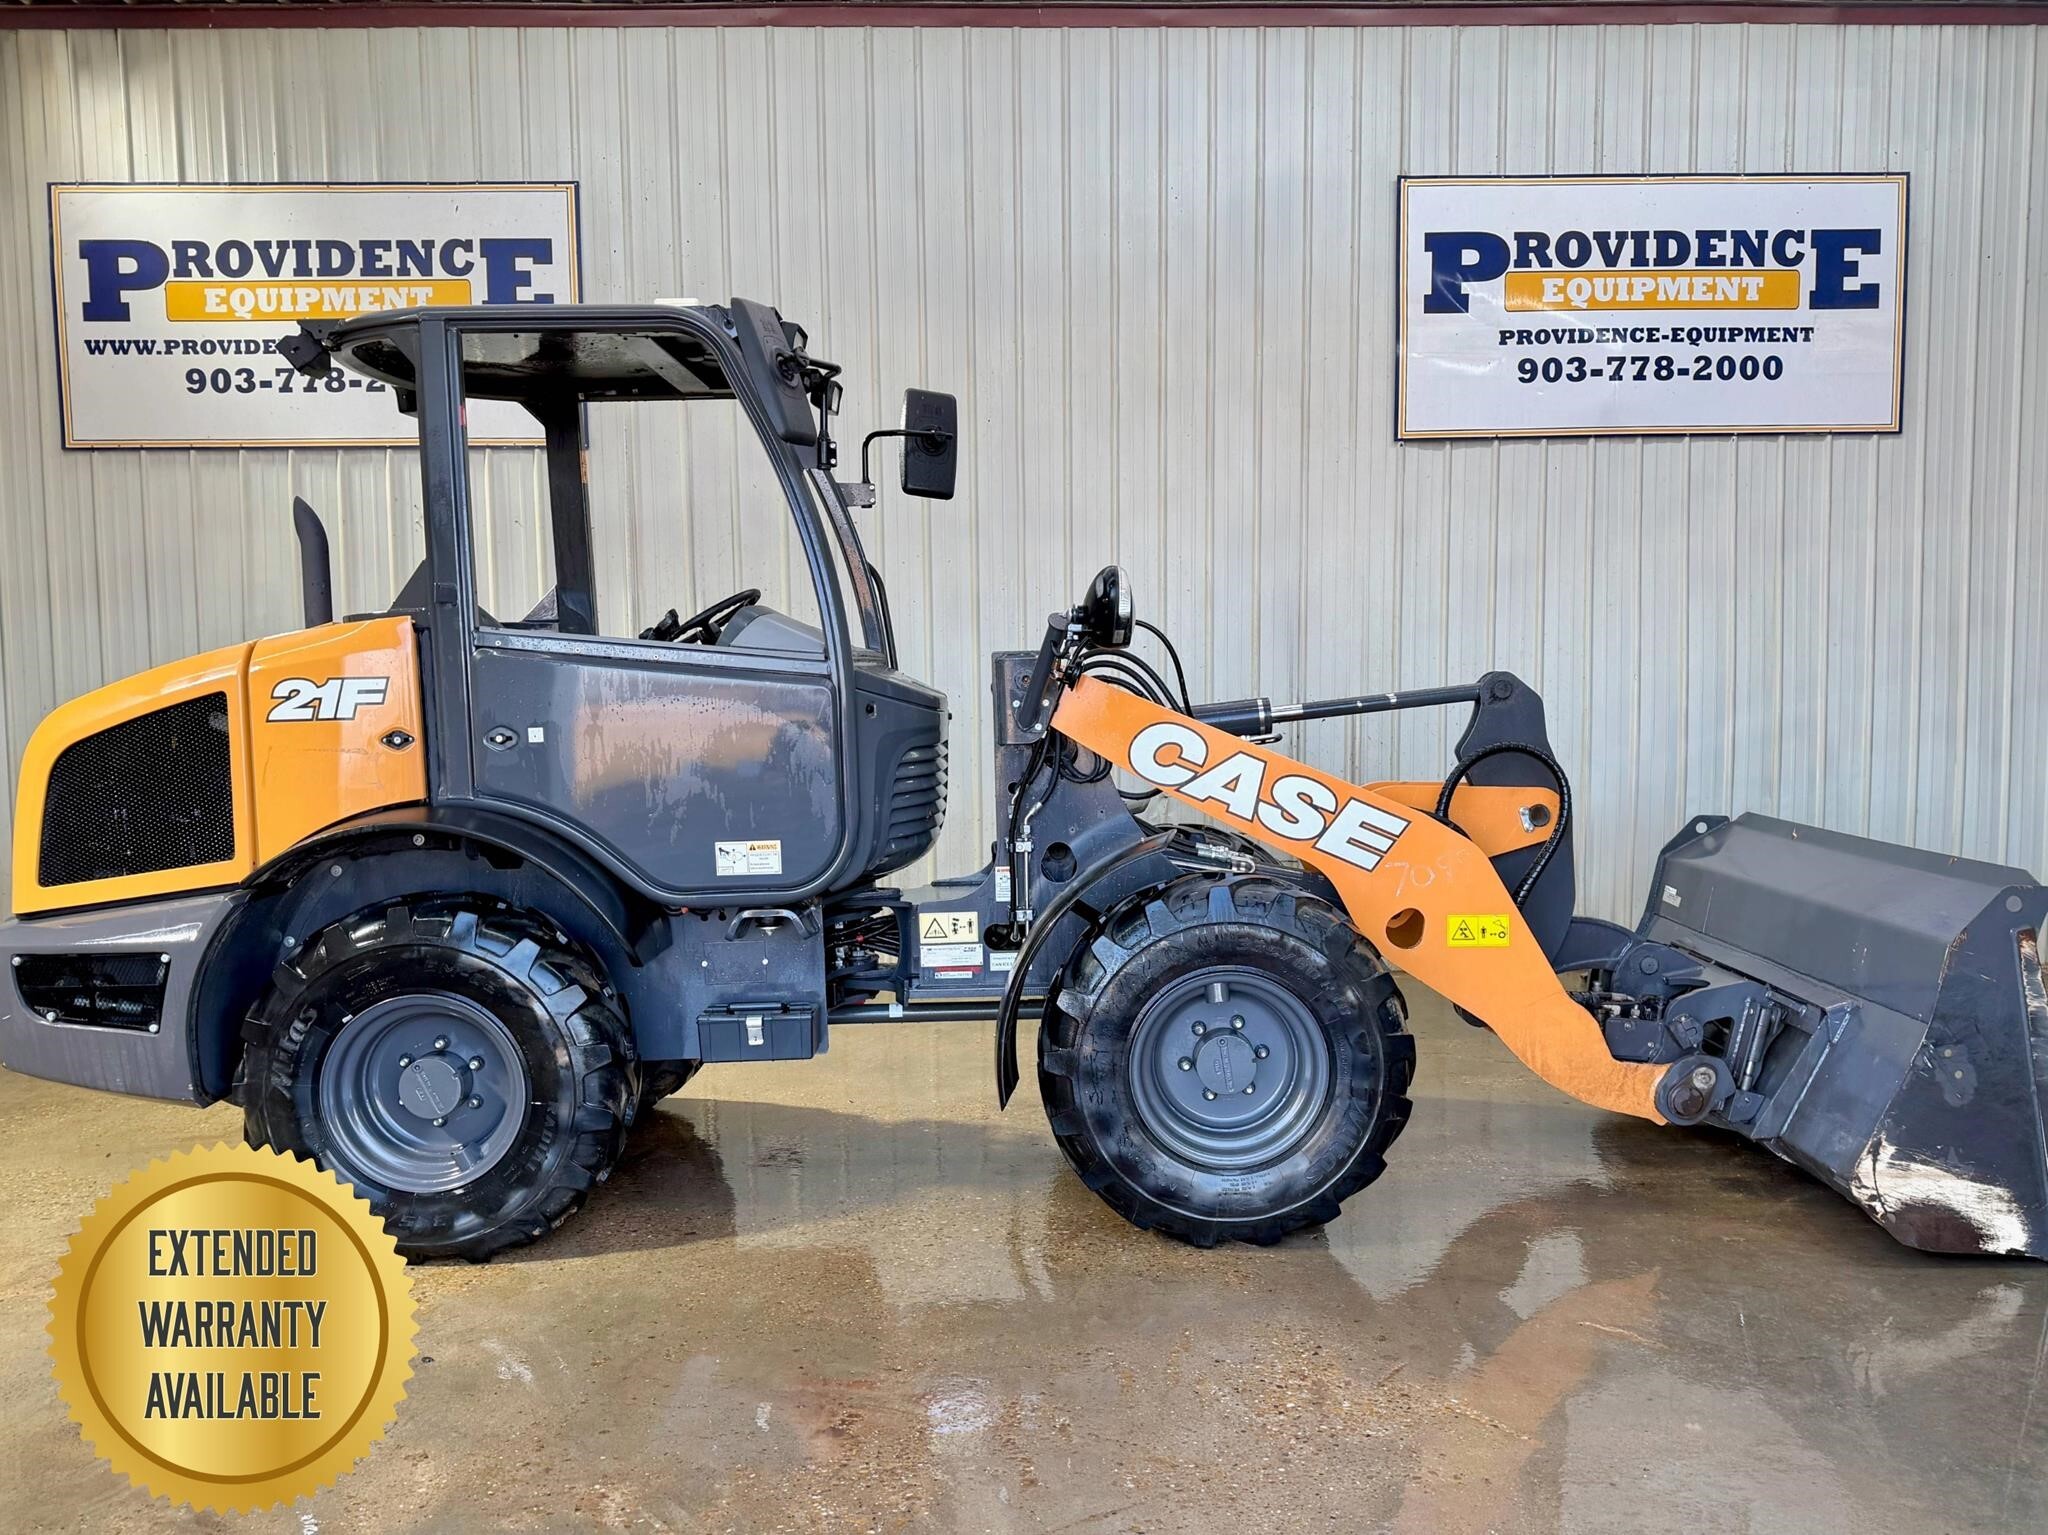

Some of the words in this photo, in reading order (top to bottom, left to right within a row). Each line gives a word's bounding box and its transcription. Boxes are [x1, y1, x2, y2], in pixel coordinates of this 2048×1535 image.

[79, 238, 554, 322] PROVIDENCE
[1424, 228, 1882, 314] PROVIDENCE
[204, 286, 434, 320] EQUIPMENT
[1542, 275, 1764, 309] EQUIPMENT
[84, 339, 279, 356] WWW.PROVIDE
[1498, 326, 1815, 347] PROVIDENCE-EQUIPMENT
[185, 367, 386, 394] 903-778-2
[1517, 355, 1785, 384] 903-778-2000
[266, 676, 390, 722] 21F
[1128, 722, 1411, 872] CASE
